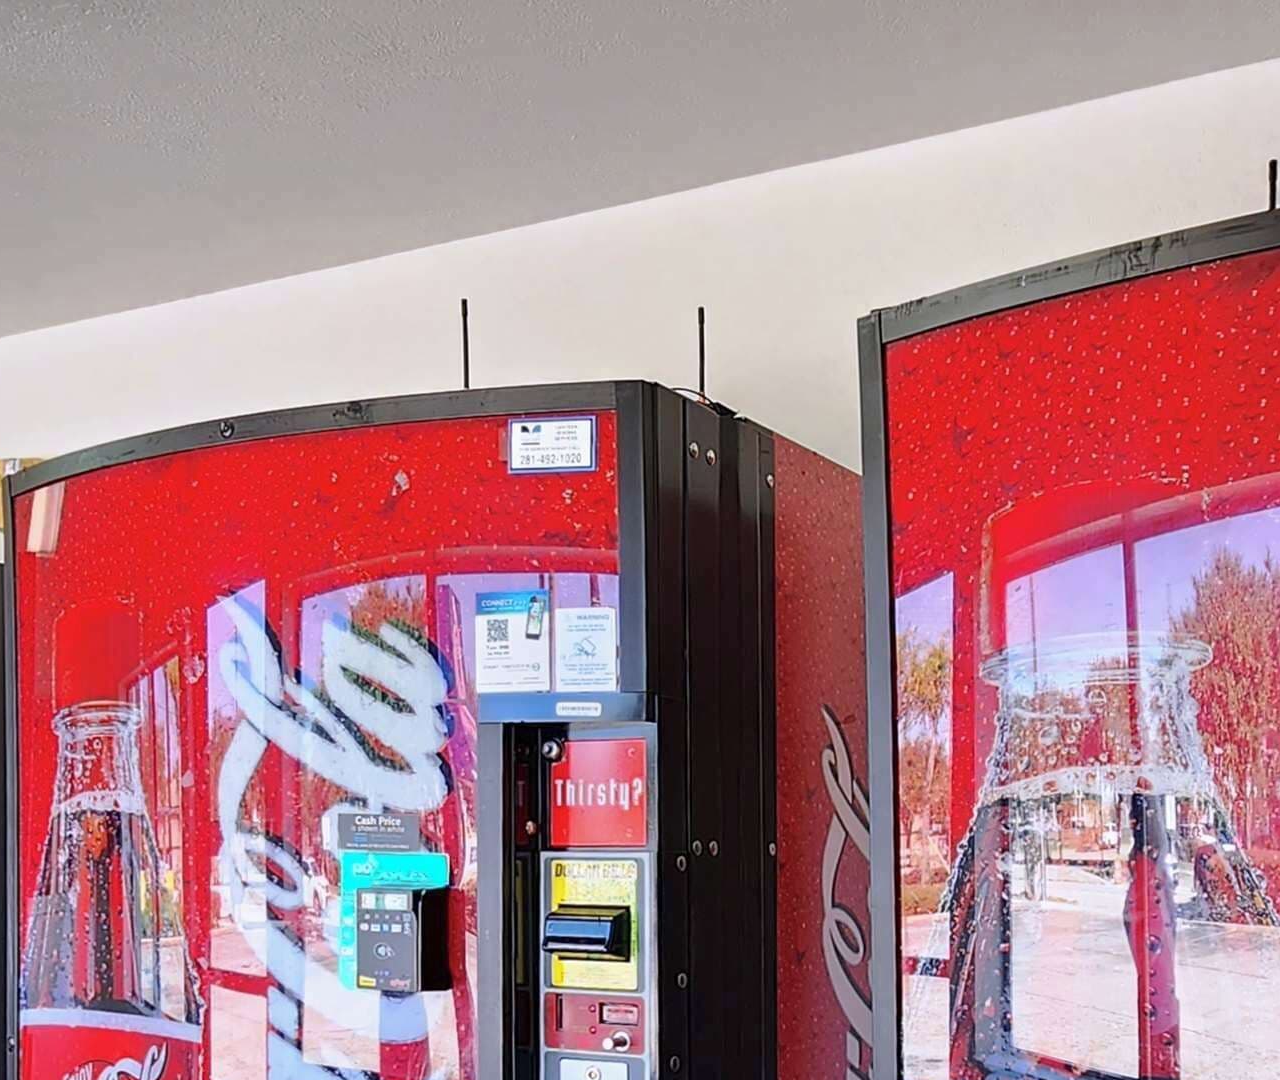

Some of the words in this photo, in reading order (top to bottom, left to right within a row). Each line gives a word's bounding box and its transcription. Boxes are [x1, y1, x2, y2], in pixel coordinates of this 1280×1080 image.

[555, 777, 642, 810] Thirsty?
[355, 816, 377, 825] Cash
[378, 816, 401, 826] Price
